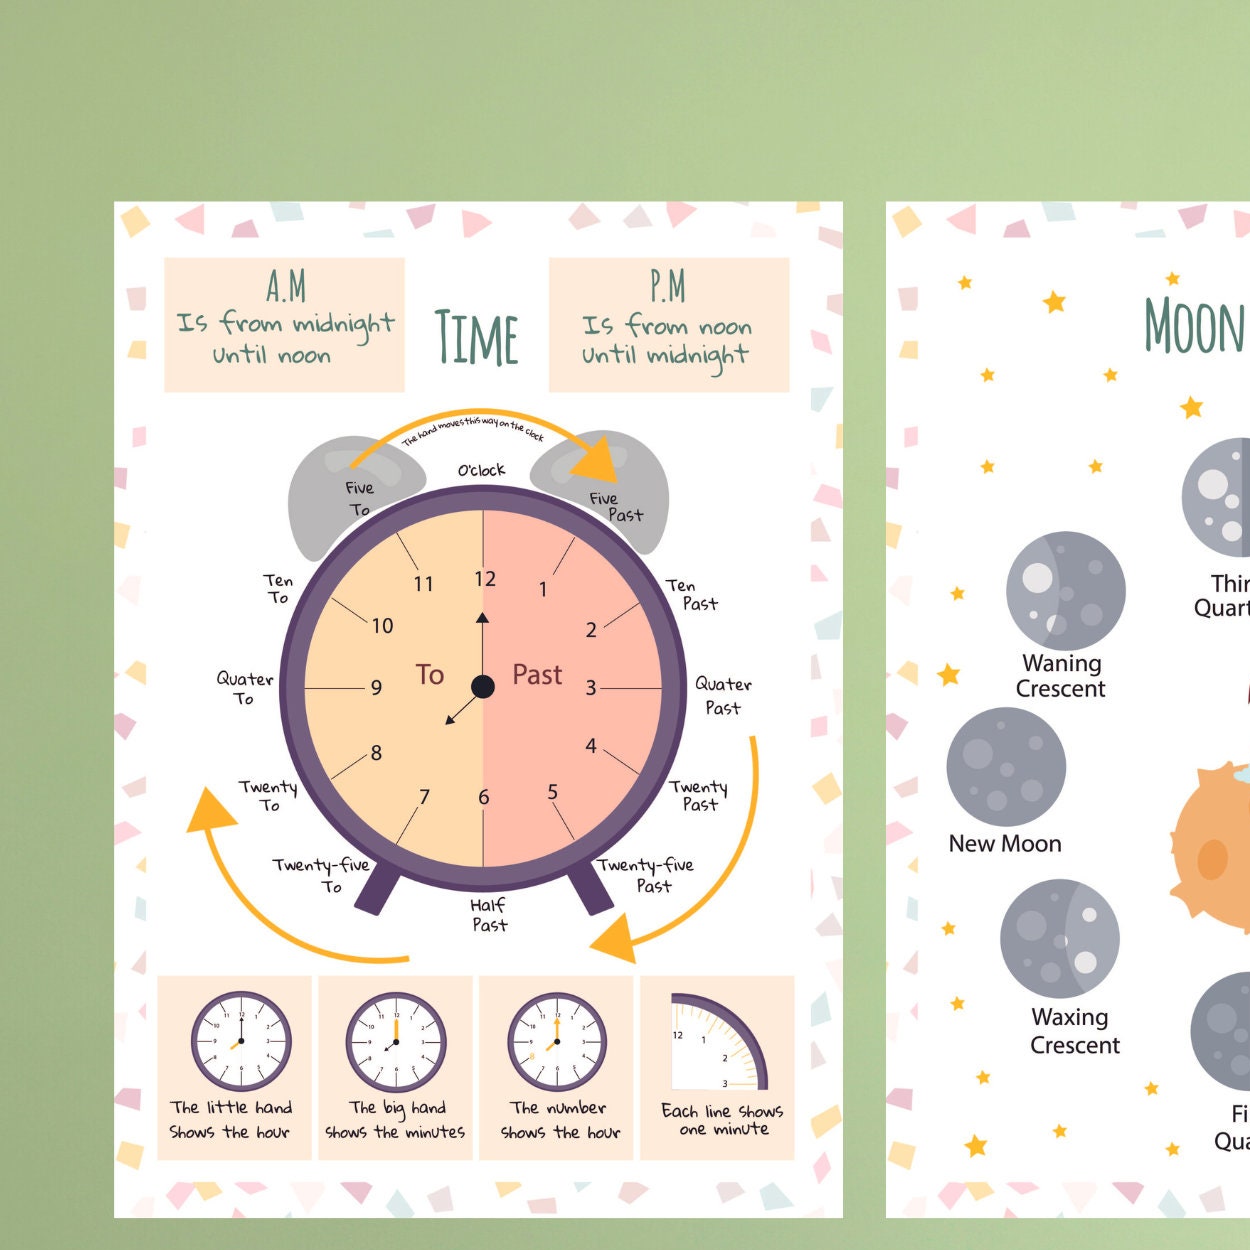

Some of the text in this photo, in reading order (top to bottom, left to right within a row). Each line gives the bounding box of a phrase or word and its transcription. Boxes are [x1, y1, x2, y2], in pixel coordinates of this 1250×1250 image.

[265, 267, 306, 304] A.M
[650, 267, 685, 304] P.M
[176, 308, 396, 347] Is from midnight
[582, 311, 752, 339] Is from noon
[277, 350, 331, 364] noon
[646, 343, 750, 379] midnight
[400, 416, 545, 448] The hand moves this way on the clock
[457, 462, 506, 477] O'clock
[345, 481, 375, 495] Five
[589, 492, 619, 505] Five
[349, 503, 371, 517] To
[607, 505, 645, 524] Past
[262, 573, 293, 587] Ten
[414, 575, 432, 592] 11
[475, 570, 496, 587] 12
[664, 579, 696, 593] Ten
[267, 590, 289, 604] To
[539, 581, 546, 598] 1
[683, 595, 719, 611] Past
[372, 617, 394, 634] 10
[585, 621, 597, 638] 2
[415, 663, 563, 686] To Past
[1022, 653, 1102, 679] Waning
[216, 669, 274, 686] Quater
[695, 675, 753, 691] Quater
[371, 679, 383, 696] 9
[585, 679, 597, 696] 3
[1016, 677, 1107, 698] Crescent
[232, 692, 254, 705] To
[706, 699, 742, 716] Past
[370, 744, 382, 761] 8
[585, 737, 597, 754] 4
[238, 779, 299, 799] Twenty
[419, 788, 430, 805] 7
[478, 788, 490, 805] 6
[547, 783, 558, 800] 5
[668, 779, 728, 799] Twenty
[258, 798, 280, 812] To
[683, 796, 719, 812] Past
[949, 833, 1062, 853] New Moon
[271, 855, 371, 877] Twenty-five
[596, 855, 695, 877] Twenty-five
[320, 880, 342, 894] To
[637, 878, 673, 894] Past
[470, 896, 506, 914] Half
[472, 916, 509, 933] Past
[1031, 1007, 1108, 1031] Waxing
[1030, 1035, 1121, 1055] Crescent
[169, 1099, 293, 1114] The little hand
[348, 1098, 447, 1124] The big hand
[508, 1099, 607, 1115] The number
[661, 1102, 699, 1118] Each
[705, 1104, 732, 1118] line
[221, 1124, 250, 1139] the
[256, 1125, 290, 1139] hour
[373, 1124, 399, 1139] the
[405, 1124, 466, 1139] minutes
[552, 1124, 581, 1139] the
[587, 1125, 621, 1139] hour
[679, 1120, 770, 1136] one minute
